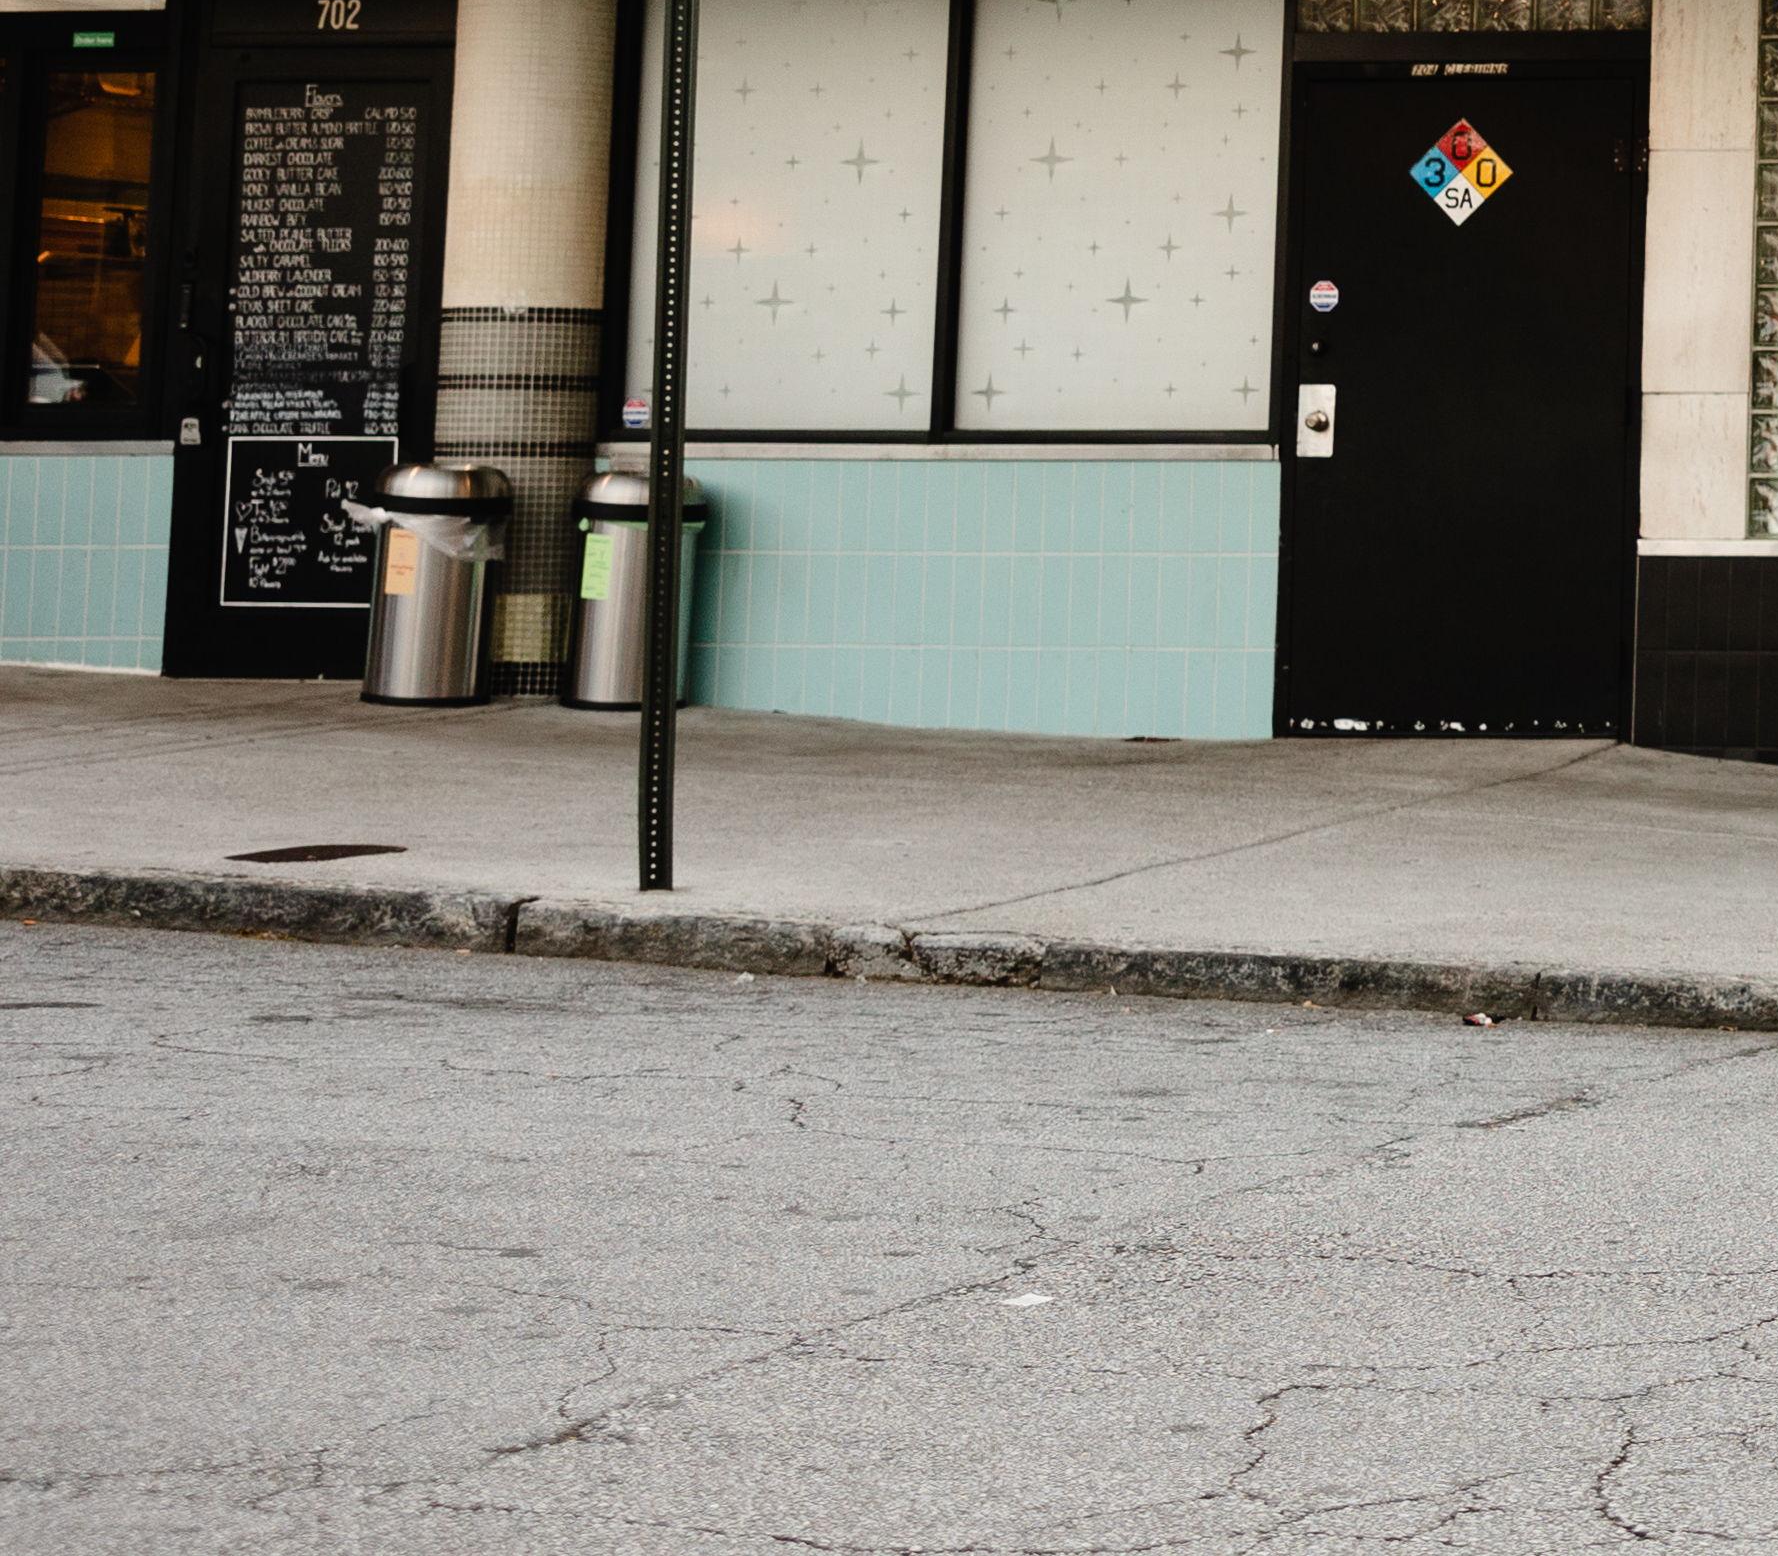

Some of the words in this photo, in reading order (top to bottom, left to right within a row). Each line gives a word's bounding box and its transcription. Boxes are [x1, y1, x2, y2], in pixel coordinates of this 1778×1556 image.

[1424, 157, 1446, 188] 3
[1476, 158, 1497, 188] 0
[1444, 188, 1473, 209] SA
